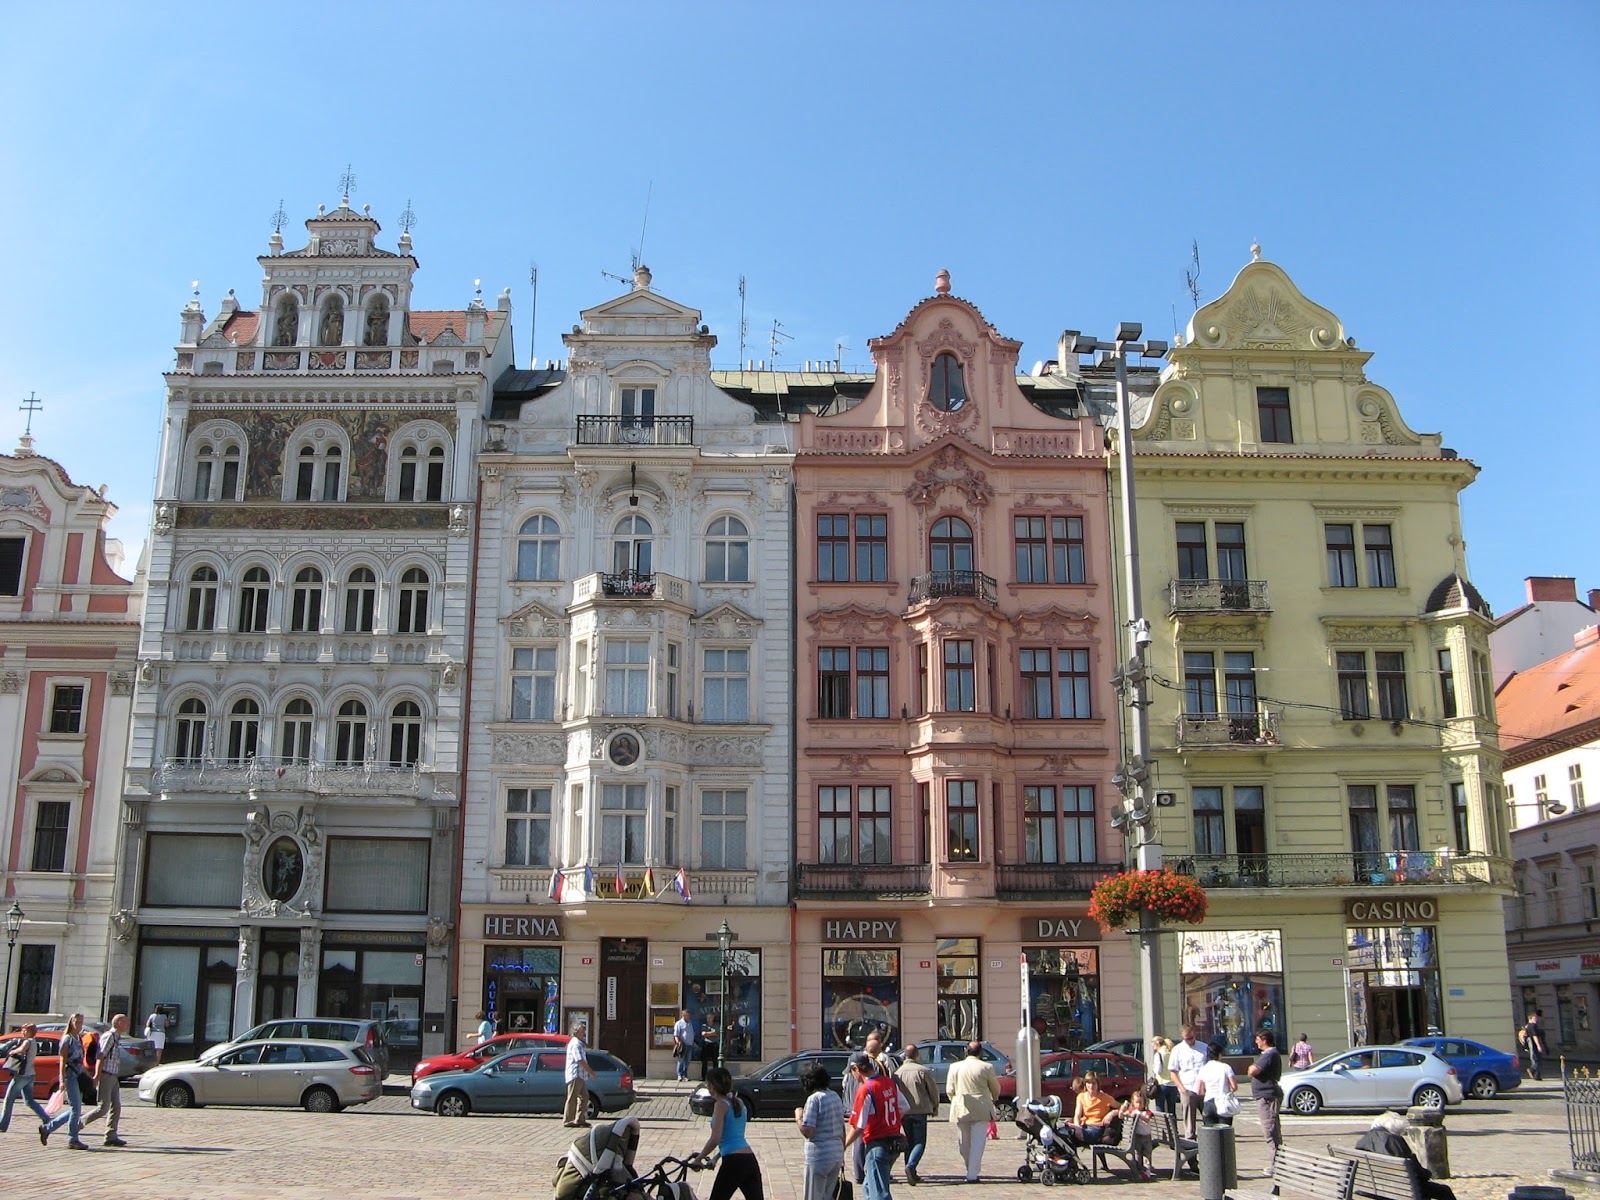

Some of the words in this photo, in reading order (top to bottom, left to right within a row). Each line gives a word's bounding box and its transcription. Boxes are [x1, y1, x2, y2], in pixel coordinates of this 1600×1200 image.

[1351, 901, 1435, 920] CASINO
[485, 917, 560, 936] HERNA
[826, 920, 897, 939] HAPPY
[1038, 919, 1082, 938] DAY
[1211, 943, 1248, 952] CASINO
[1203, 954, 1235, 963] HAPPY
[884, 1097, 897, 1127] 15
